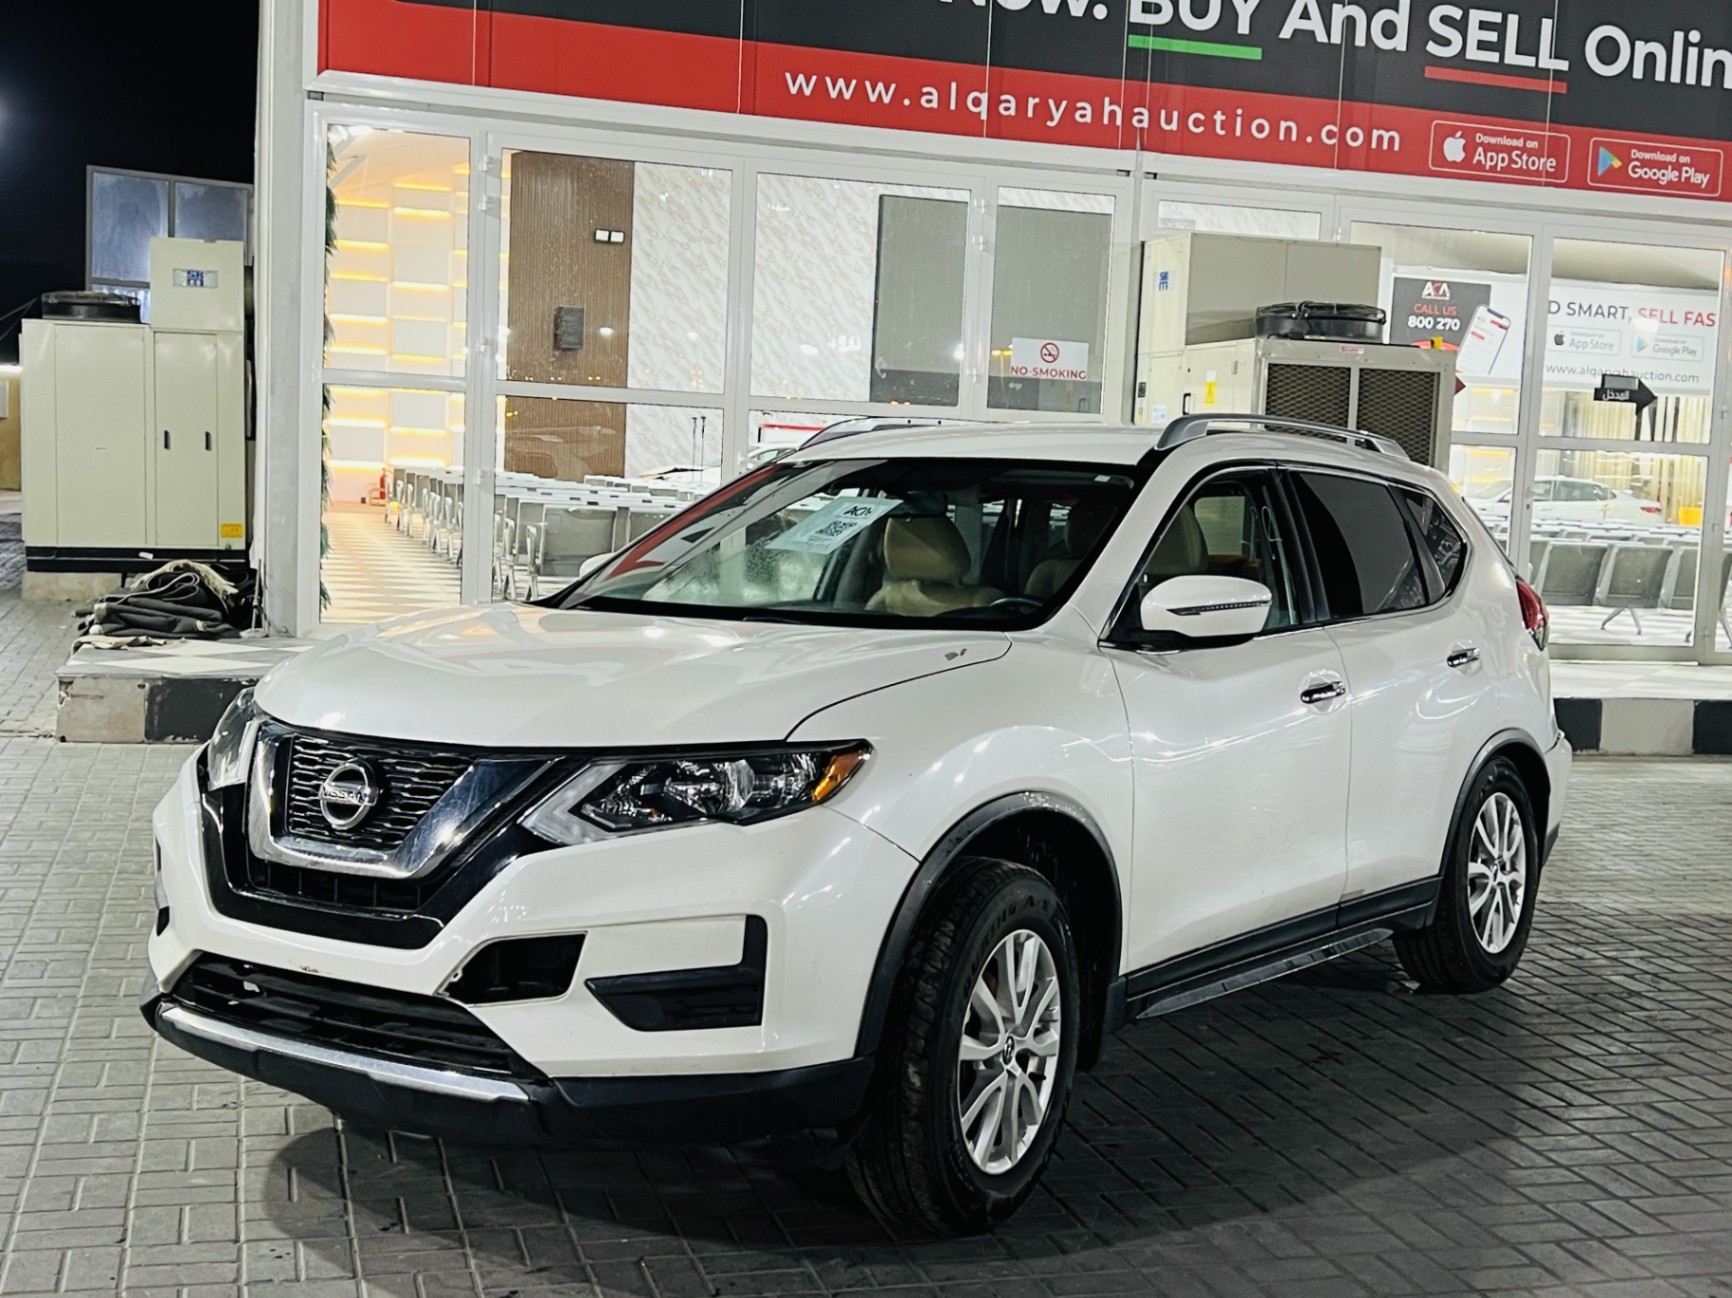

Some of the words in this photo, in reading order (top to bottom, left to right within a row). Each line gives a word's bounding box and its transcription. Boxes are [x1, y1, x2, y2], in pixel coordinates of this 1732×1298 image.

[1279, 0, 1410, 51] And
[1426, 5, 1569, 71] SELL
[785, 69, 1401, 152] www.alqaryahauction.com
[1475, 133, 1524, 148] Download
[1526, 140, 1539, 149] on
[1473, 146, 1509, 171] App
[1511, 150, 1557, 172] Store
[1631, 149, 1677, 162] Download
[1679, 155, 1691, 164] on
[1628, 161, 1679, 185] Google
[1681, 166, 1711, 189] Play
[1414, 303, 1440, 315] CALL
[1443, 306, 1457, 316] US
[1638, 307, 1679, 325] SELL
[1408, 315, 1434, 329] 800
[1436, 317, 1461, 331] 270
[1569, 338, 1589, 351] App
[1590, 340, 1615, 351] Store
[1653, 343, 1680, 357] Google
[1682, 346, 1697, 358] Play
